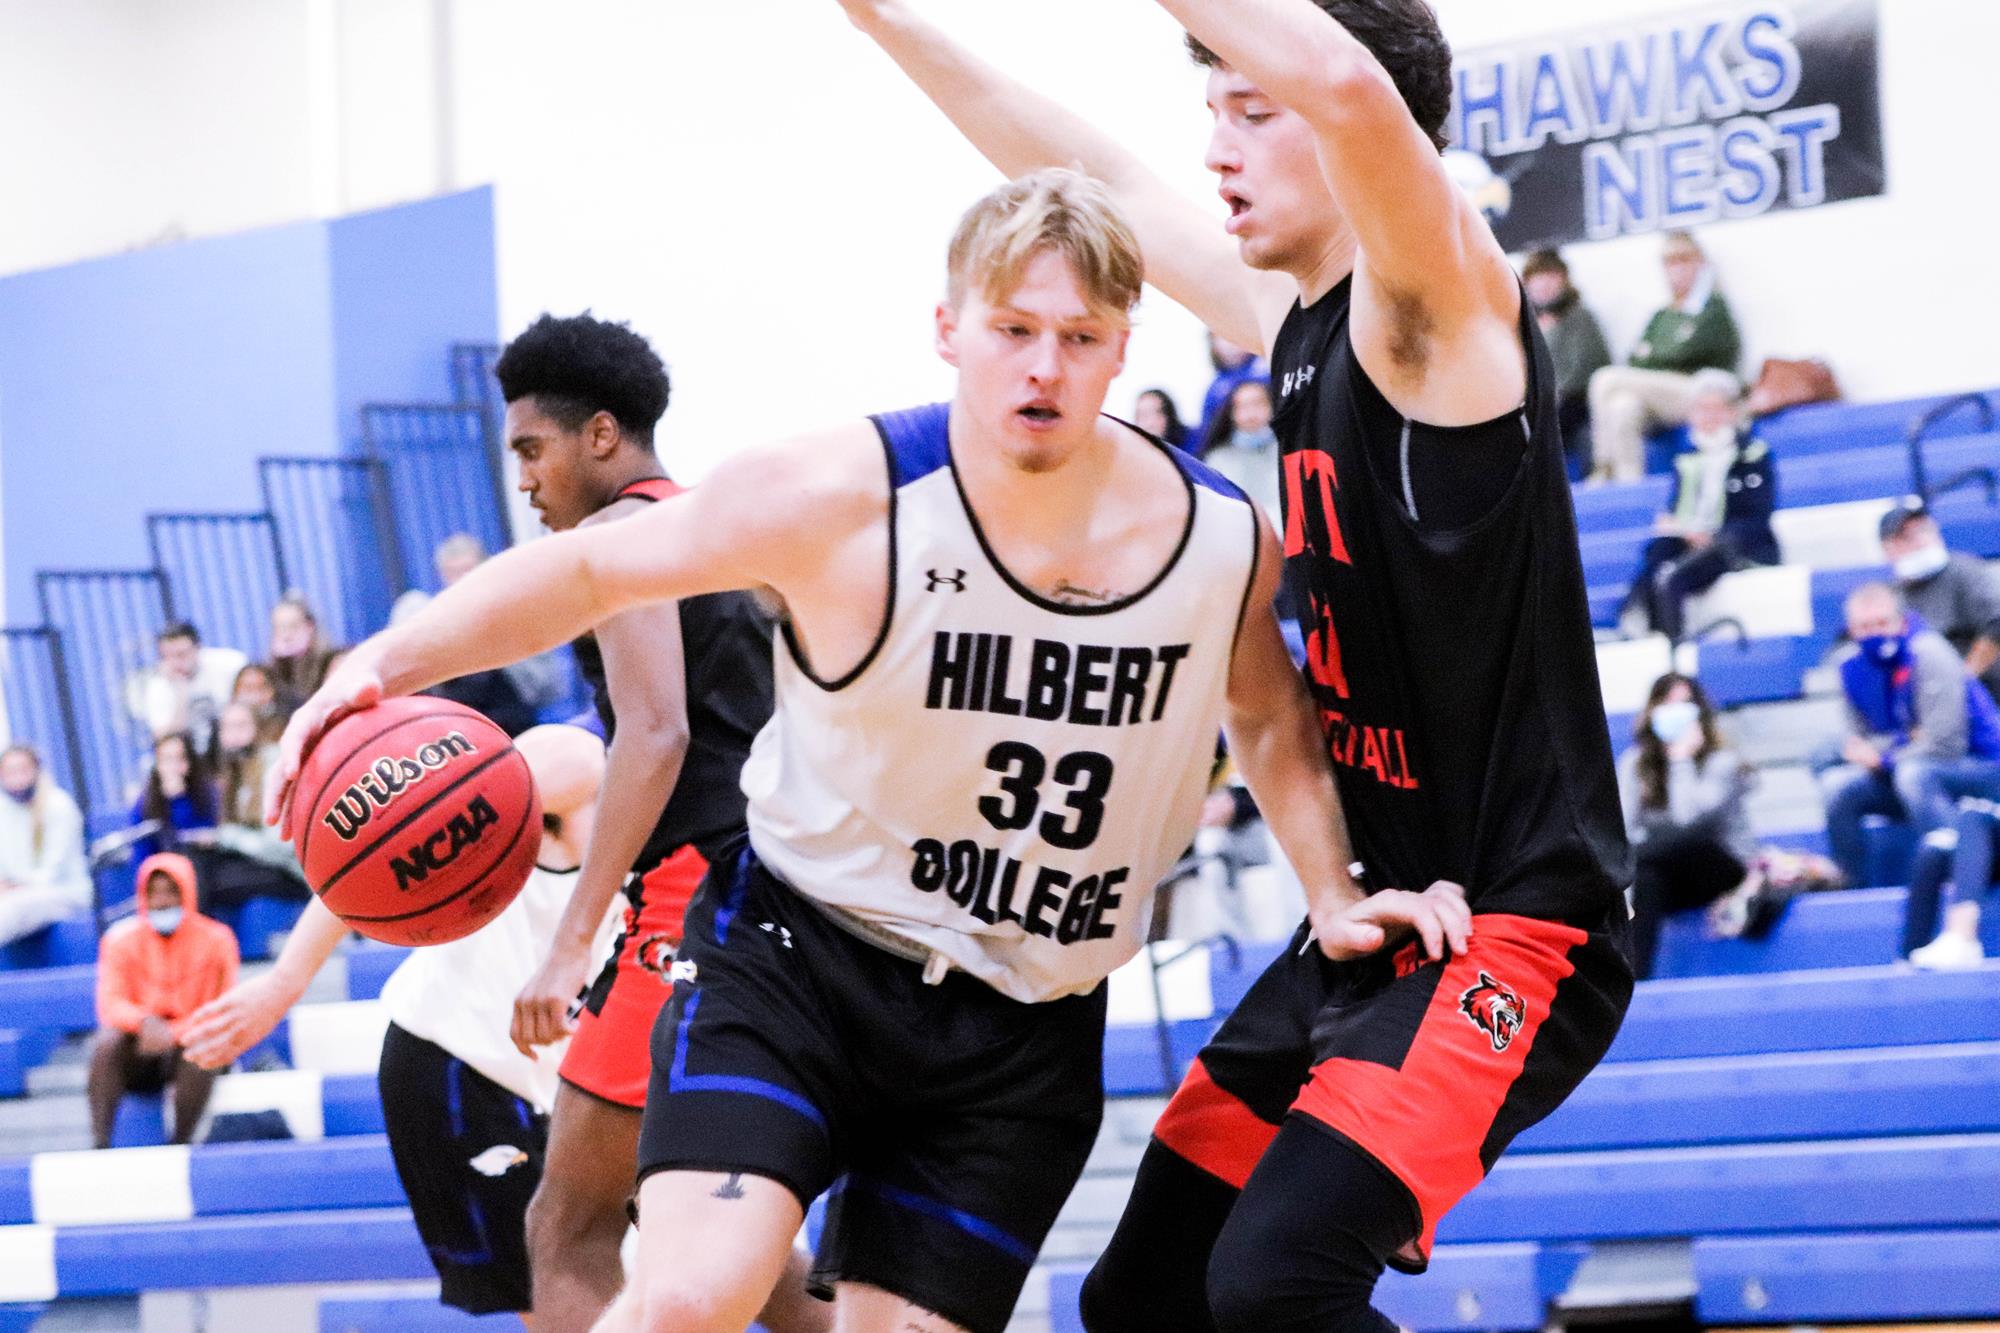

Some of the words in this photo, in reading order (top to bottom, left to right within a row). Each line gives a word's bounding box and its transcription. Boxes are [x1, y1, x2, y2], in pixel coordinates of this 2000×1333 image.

[1454, 6, 1799, 156] HAWKS
[1586, 106, 1838, 238] NEST
[925, 631, 1191, 727] HILBERT
[322, 731, 477, 841] Wilson
[978, 740, 1114, 850] 33
[389, 794, 499, 892] NCAA
[910, 838, 1130, 946] COLLEGE
